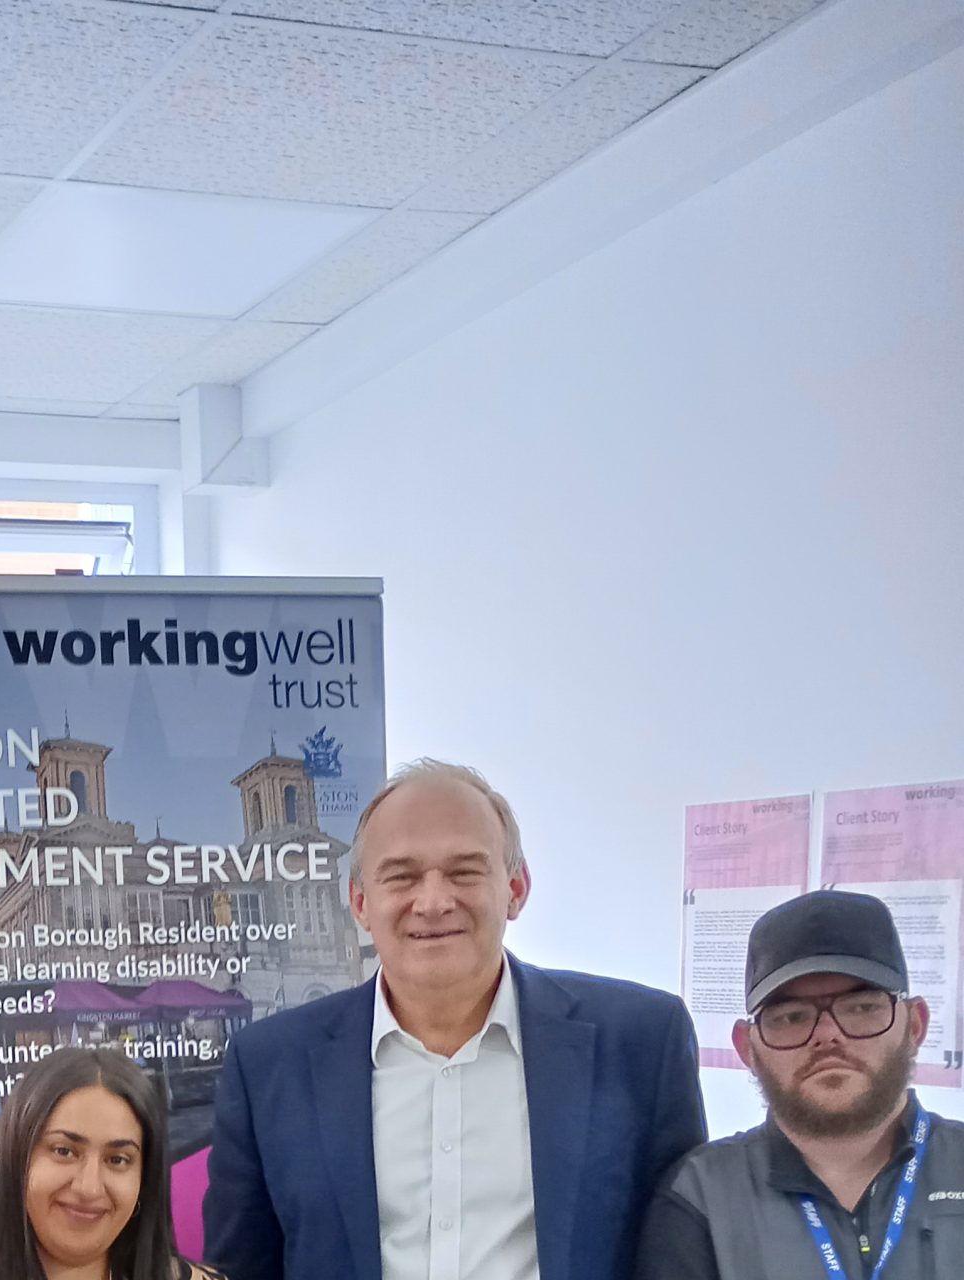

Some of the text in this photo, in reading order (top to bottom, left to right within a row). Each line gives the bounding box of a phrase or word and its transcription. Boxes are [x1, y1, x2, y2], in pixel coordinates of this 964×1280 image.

[268, 673, 359, 709] trust
[693, 821, 749, 837] Client Story
[836, 809, 901, 826] Client Story
[145, 841, 334, 885] SERVICE
[33, 923, 132, 951] Borough
[138, 919, 240, 945] Resident
[245, 922, 298, 942] over
[16, 956, 111, 984] learning
[116, 953, 221, 979] disability
[226, 955, 252, 975] or
[123, 1034, 219, 1061] training,
[914, 1119, 927, 1144] STAFF
[904, 1156, 919, 1184] STAFF
[893, 1195, 908, 1225] STAFF
[820, 1242, 841, 1272] STAFF
